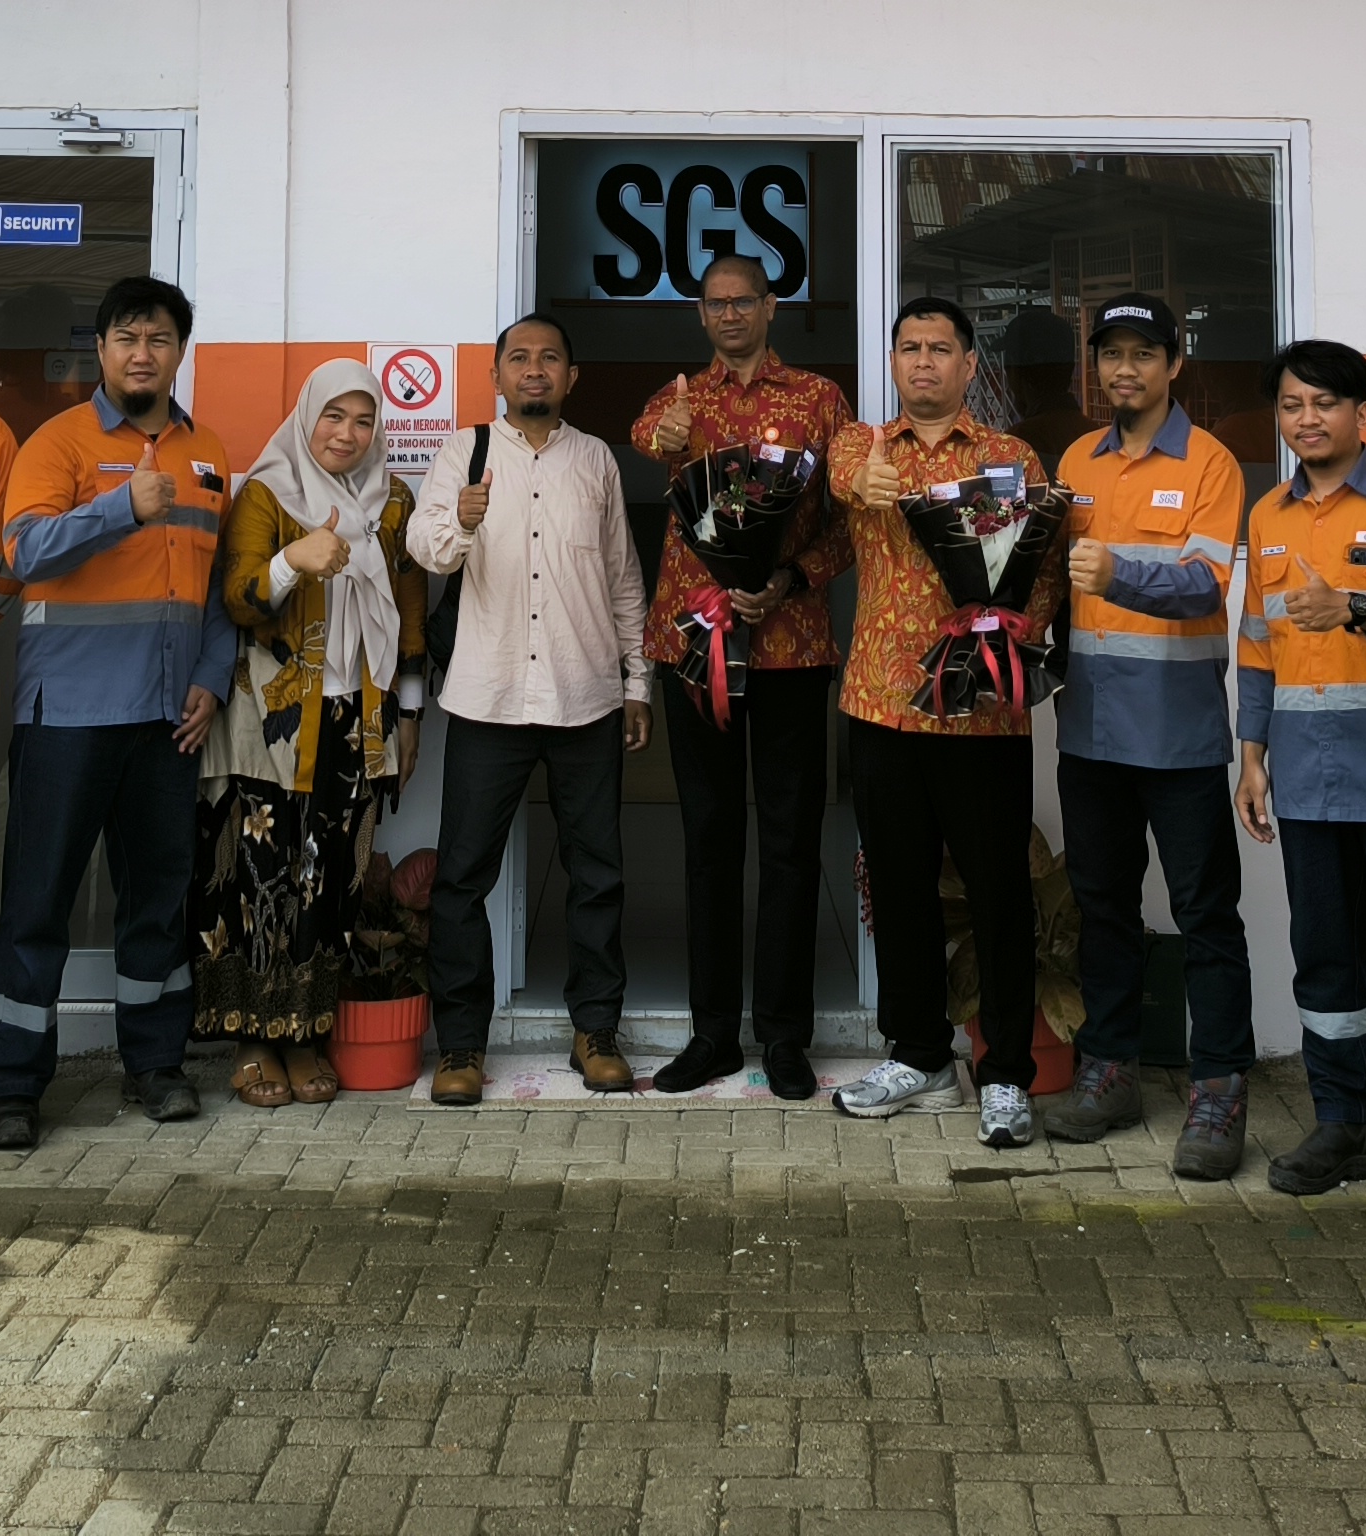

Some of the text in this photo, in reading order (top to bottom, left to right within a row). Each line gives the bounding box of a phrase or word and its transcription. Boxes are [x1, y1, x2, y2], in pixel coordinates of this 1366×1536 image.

[3, 216, 76, 231] SECURITY
[592, 163, 807, 299] SGS
[1103, 305, 1153, 321] CRESSIDA
[385, 418, 451, 432] ARANG MEROKOK
[387, 438, 444, 449] O SMOKING
[1158, 493, 1178, 506] SGS
